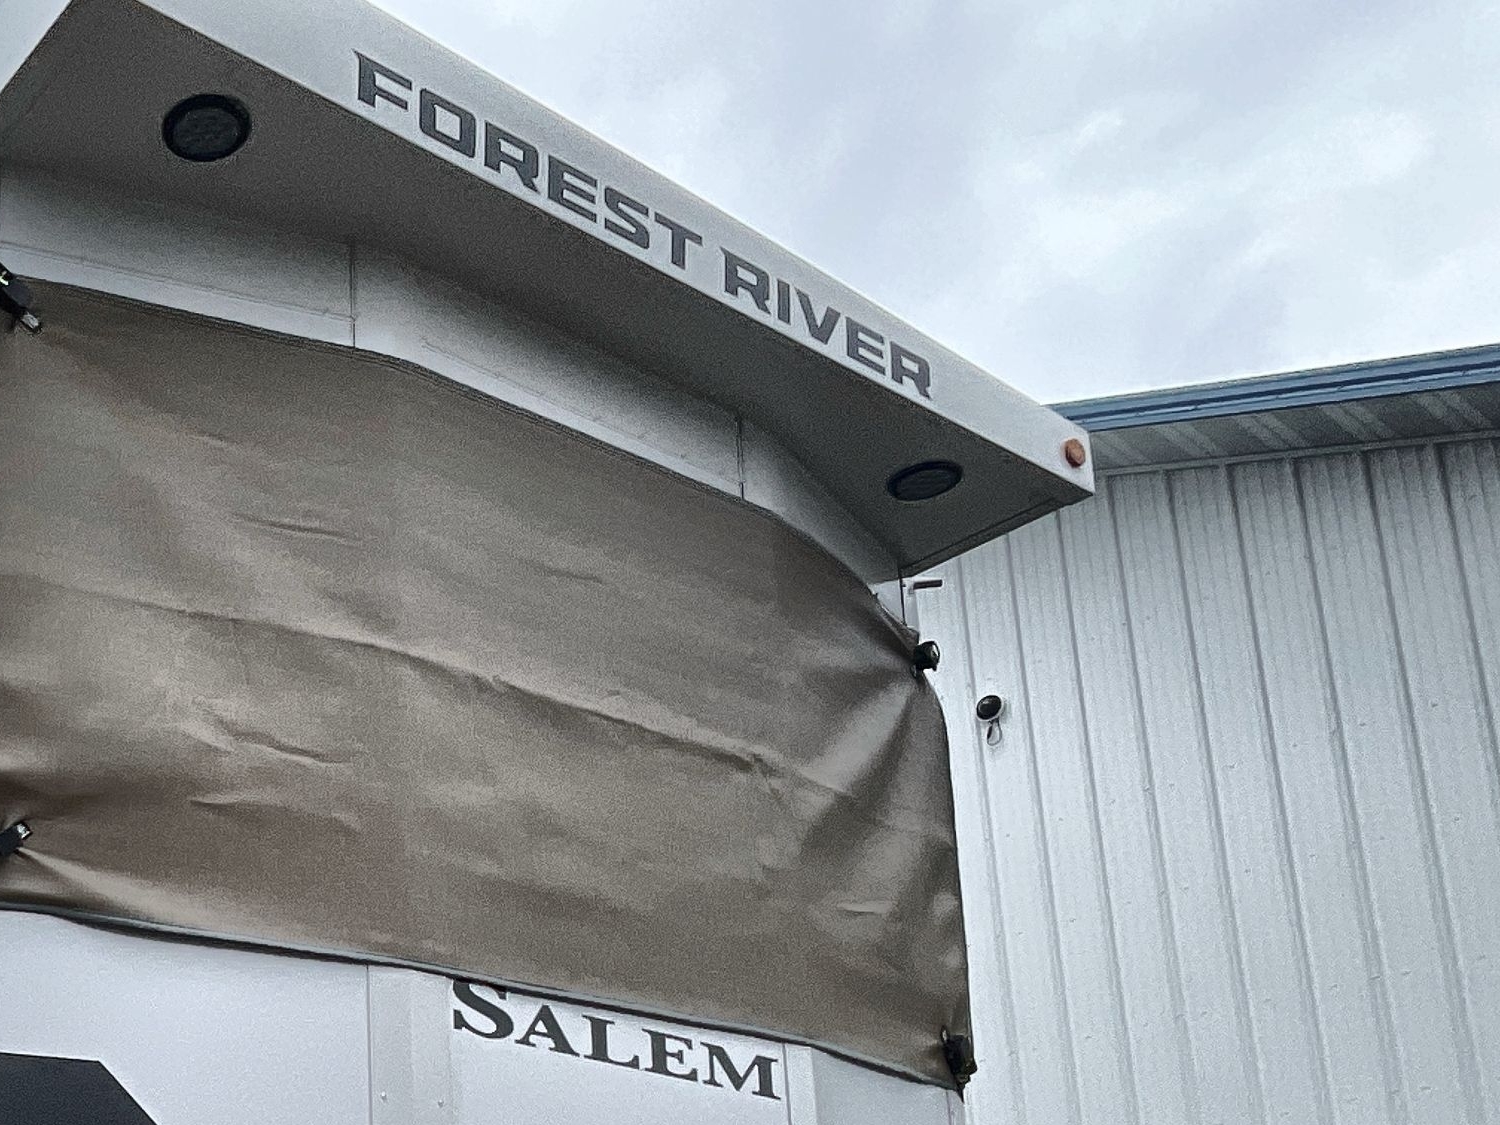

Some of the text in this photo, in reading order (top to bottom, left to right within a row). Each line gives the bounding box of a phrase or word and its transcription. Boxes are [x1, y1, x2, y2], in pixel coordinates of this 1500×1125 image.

[352, 48, 934, 400] FOREST RIVER
[452, 979, 782, 1101] SALEM
